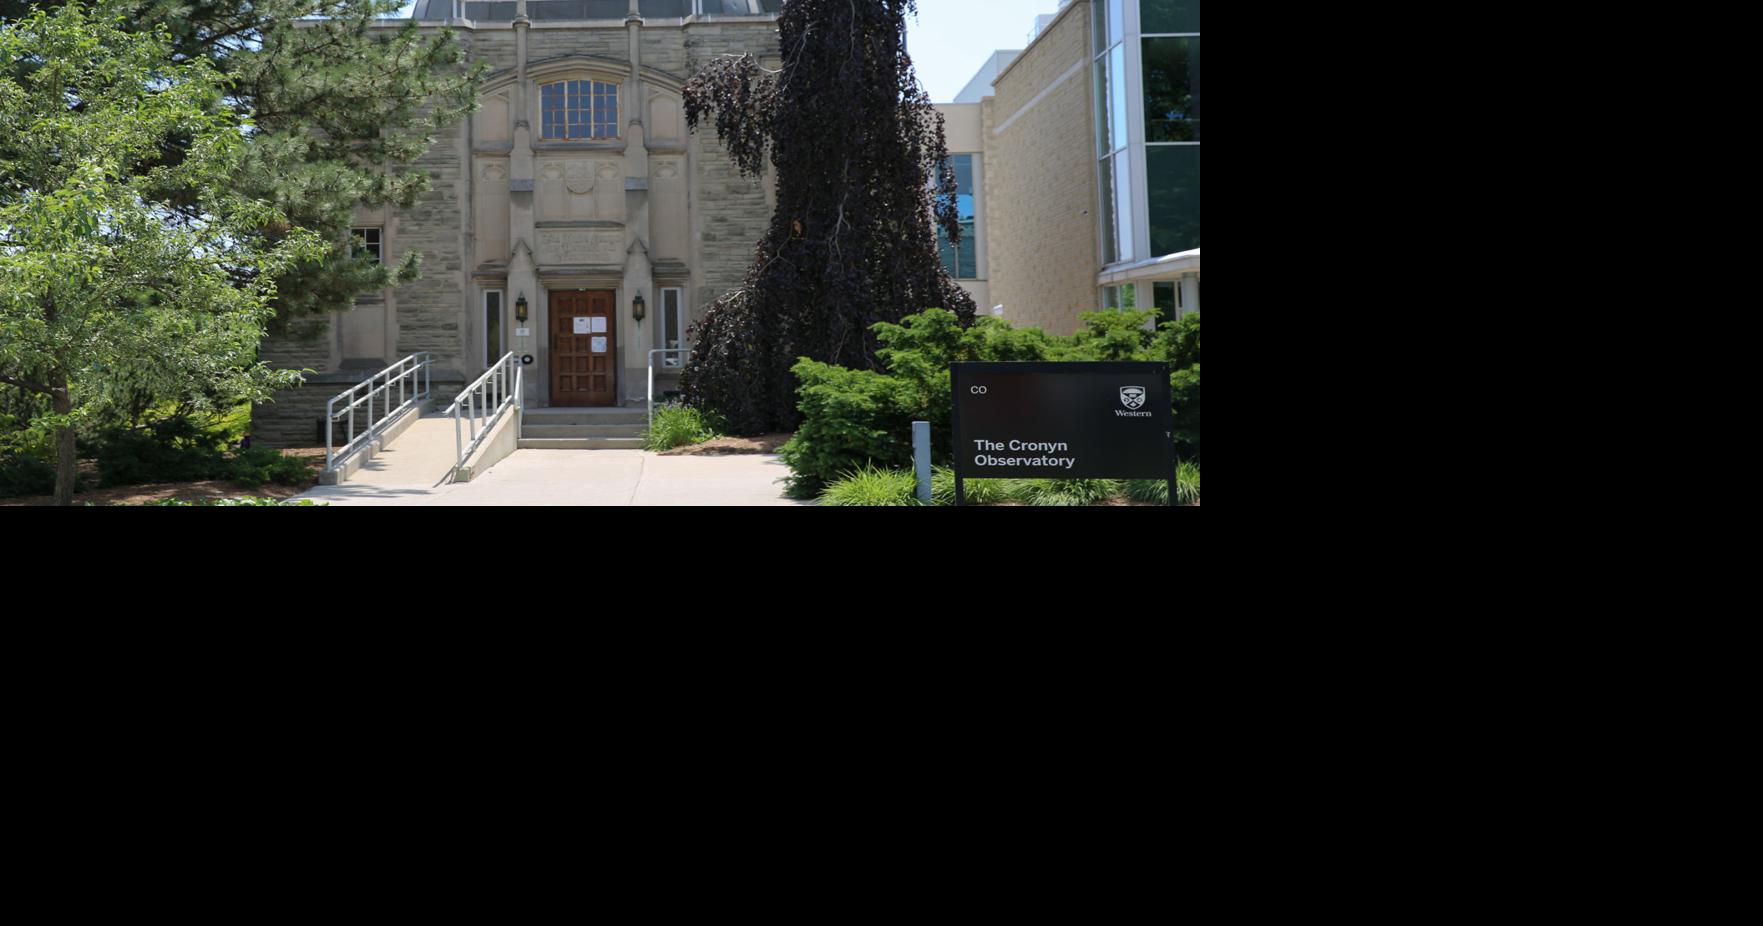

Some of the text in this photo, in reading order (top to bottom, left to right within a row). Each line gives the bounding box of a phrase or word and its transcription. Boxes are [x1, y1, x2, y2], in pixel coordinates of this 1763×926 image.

[970, 385, 988, 395] CO
[1114, 409, 1152, 417] Western
[973, 439, 1068, 454] The Cronyn
[974, 454, 1076, 469] Observatory
